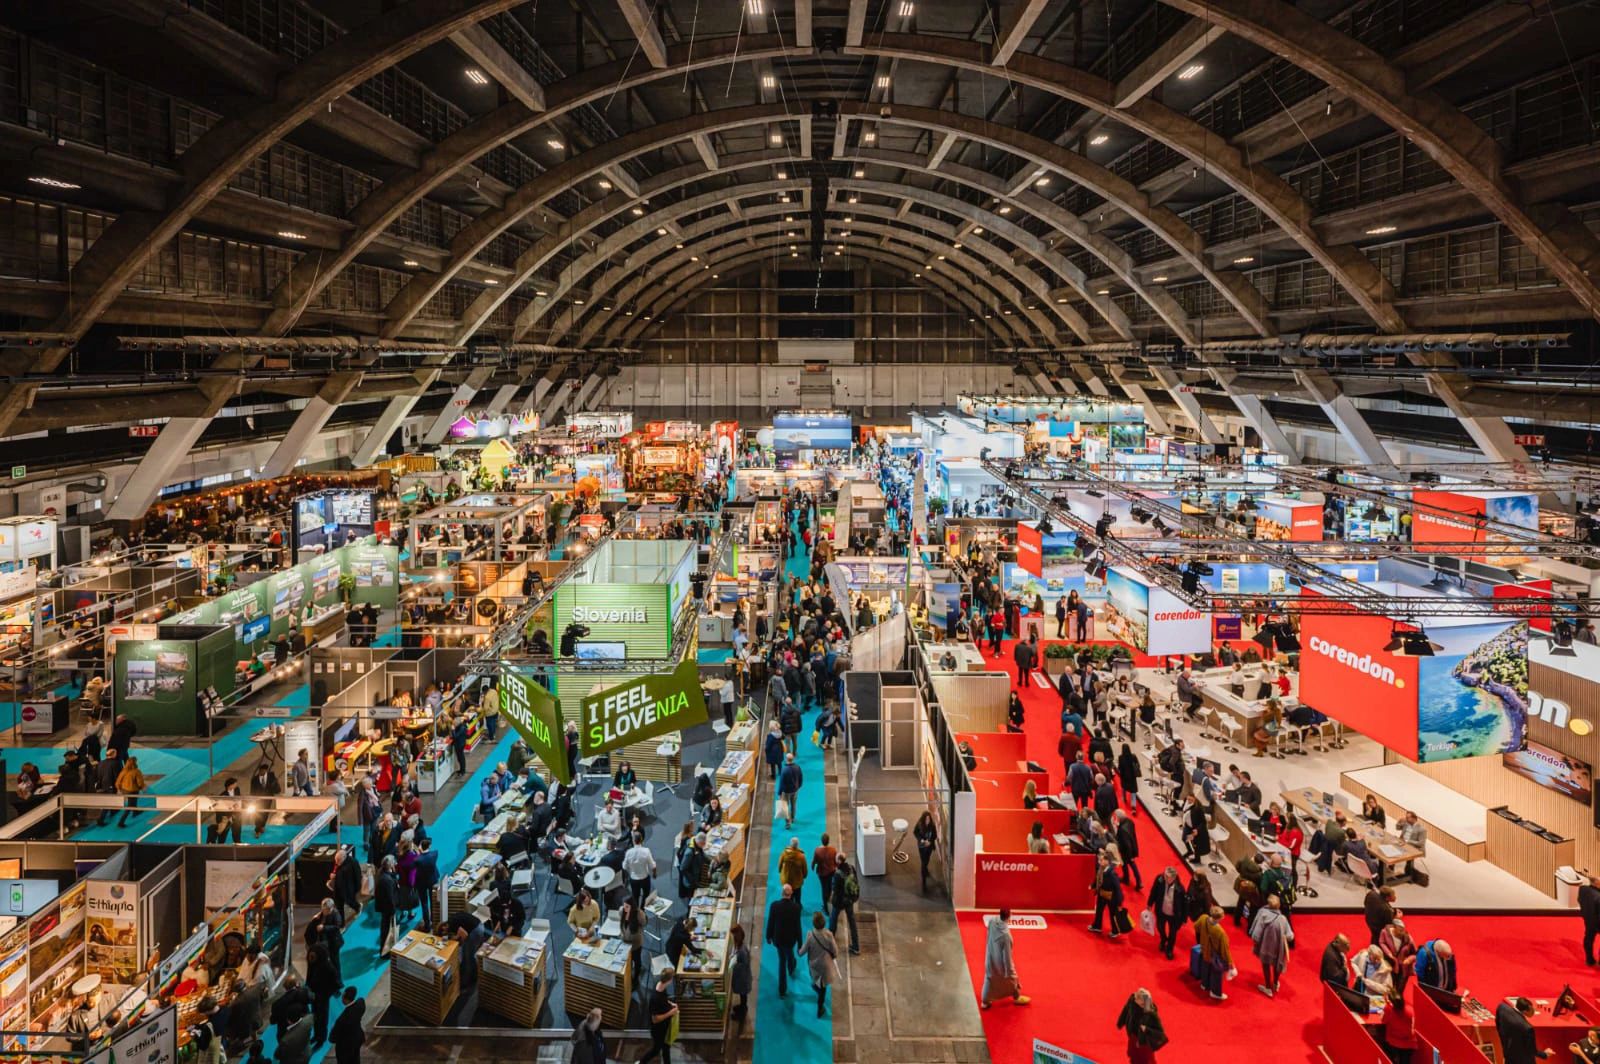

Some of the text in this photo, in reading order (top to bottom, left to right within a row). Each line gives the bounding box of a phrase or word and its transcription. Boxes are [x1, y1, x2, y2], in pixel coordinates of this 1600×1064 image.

[572, 606, 648, 623] Slovenia
[506, 673, 531, 707] FEEL
[589, 684, 652, 725] I FEEL
[500, 690, 552, 749] SLOVENIA
[590, 691, 689, 748] SLOVENIA
